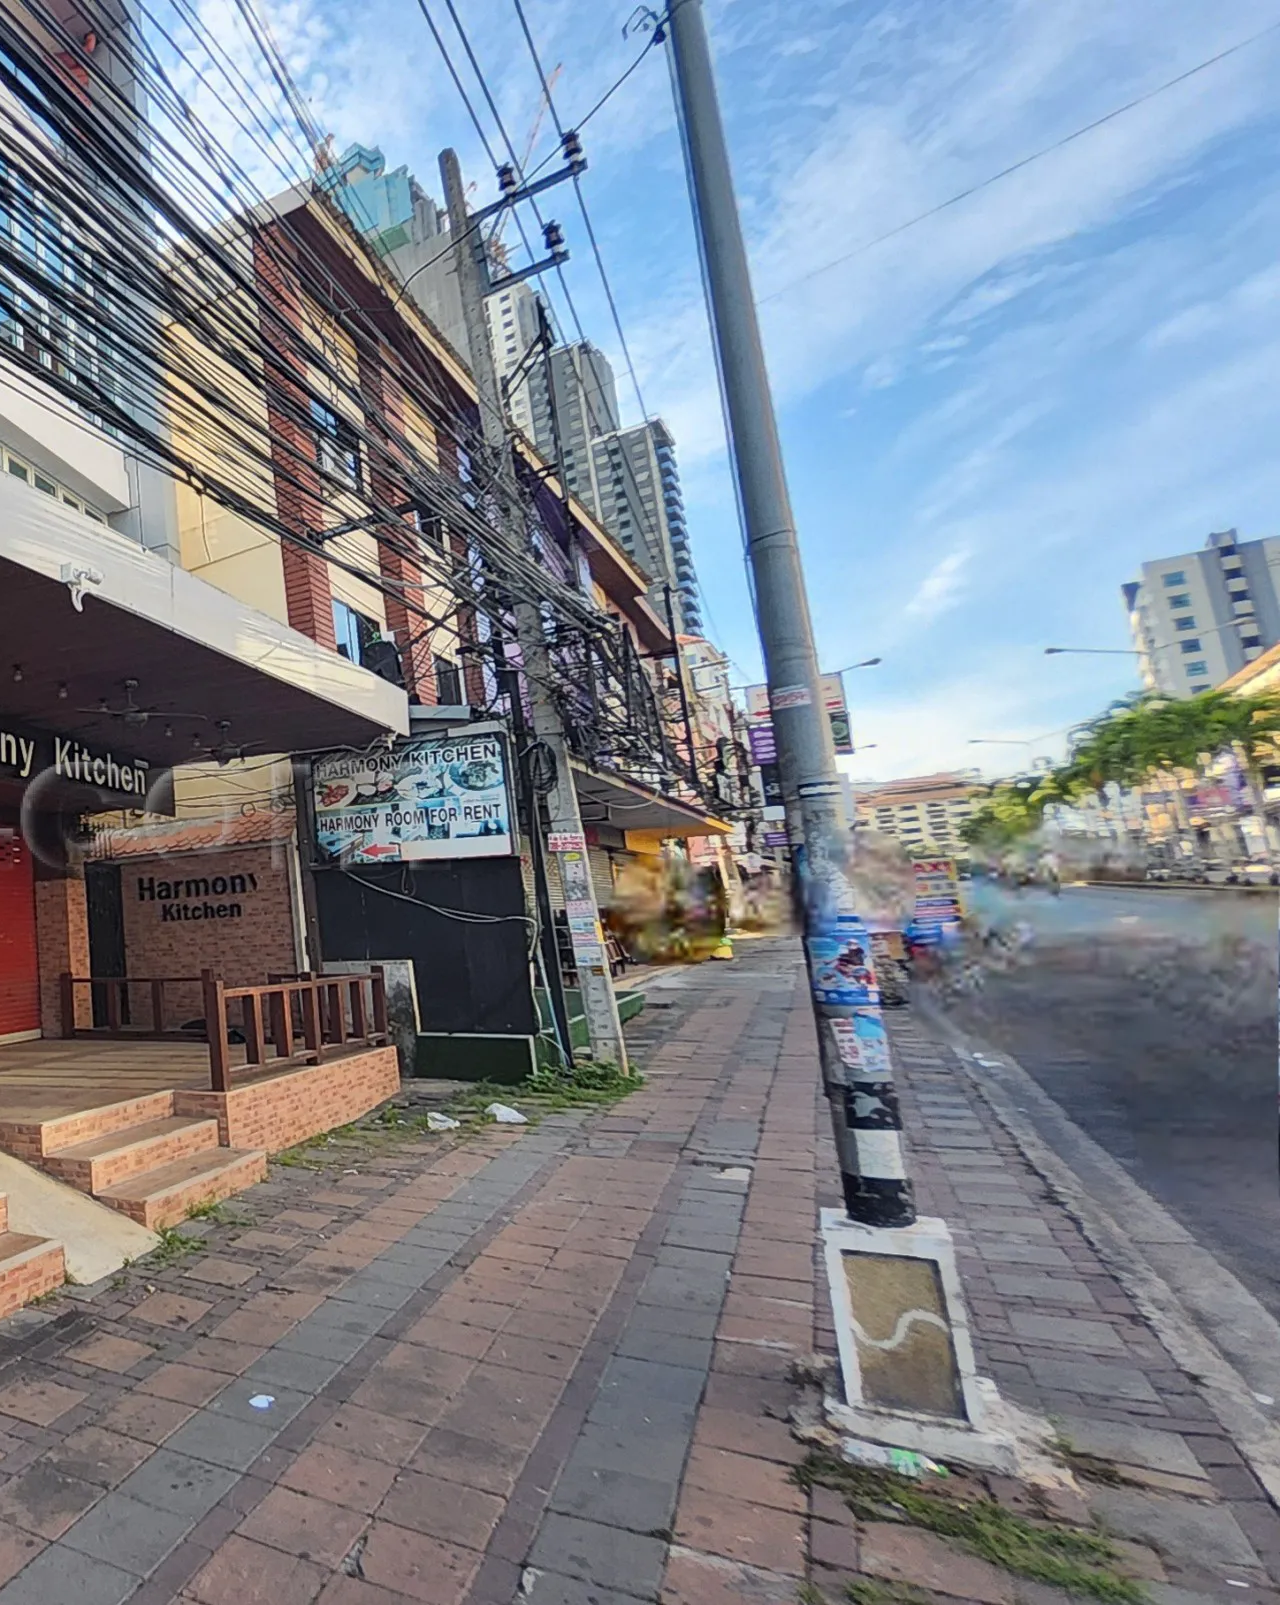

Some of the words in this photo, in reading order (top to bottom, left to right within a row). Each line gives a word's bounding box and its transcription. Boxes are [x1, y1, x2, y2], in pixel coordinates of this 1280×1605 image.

[54, 737, 148, 796] Kitchen
[315, 755, 403, 779] HARMONY
[411, 743, 497, 766] KITCHEN
[320, 813, 379, 832] HARMONY
[385, 809, 426, 826] ROOM
[431, 807, 457, 822] FOR
[464, 803, 502, 821] RENT
[161, 902, 242, 922] Kitchen
